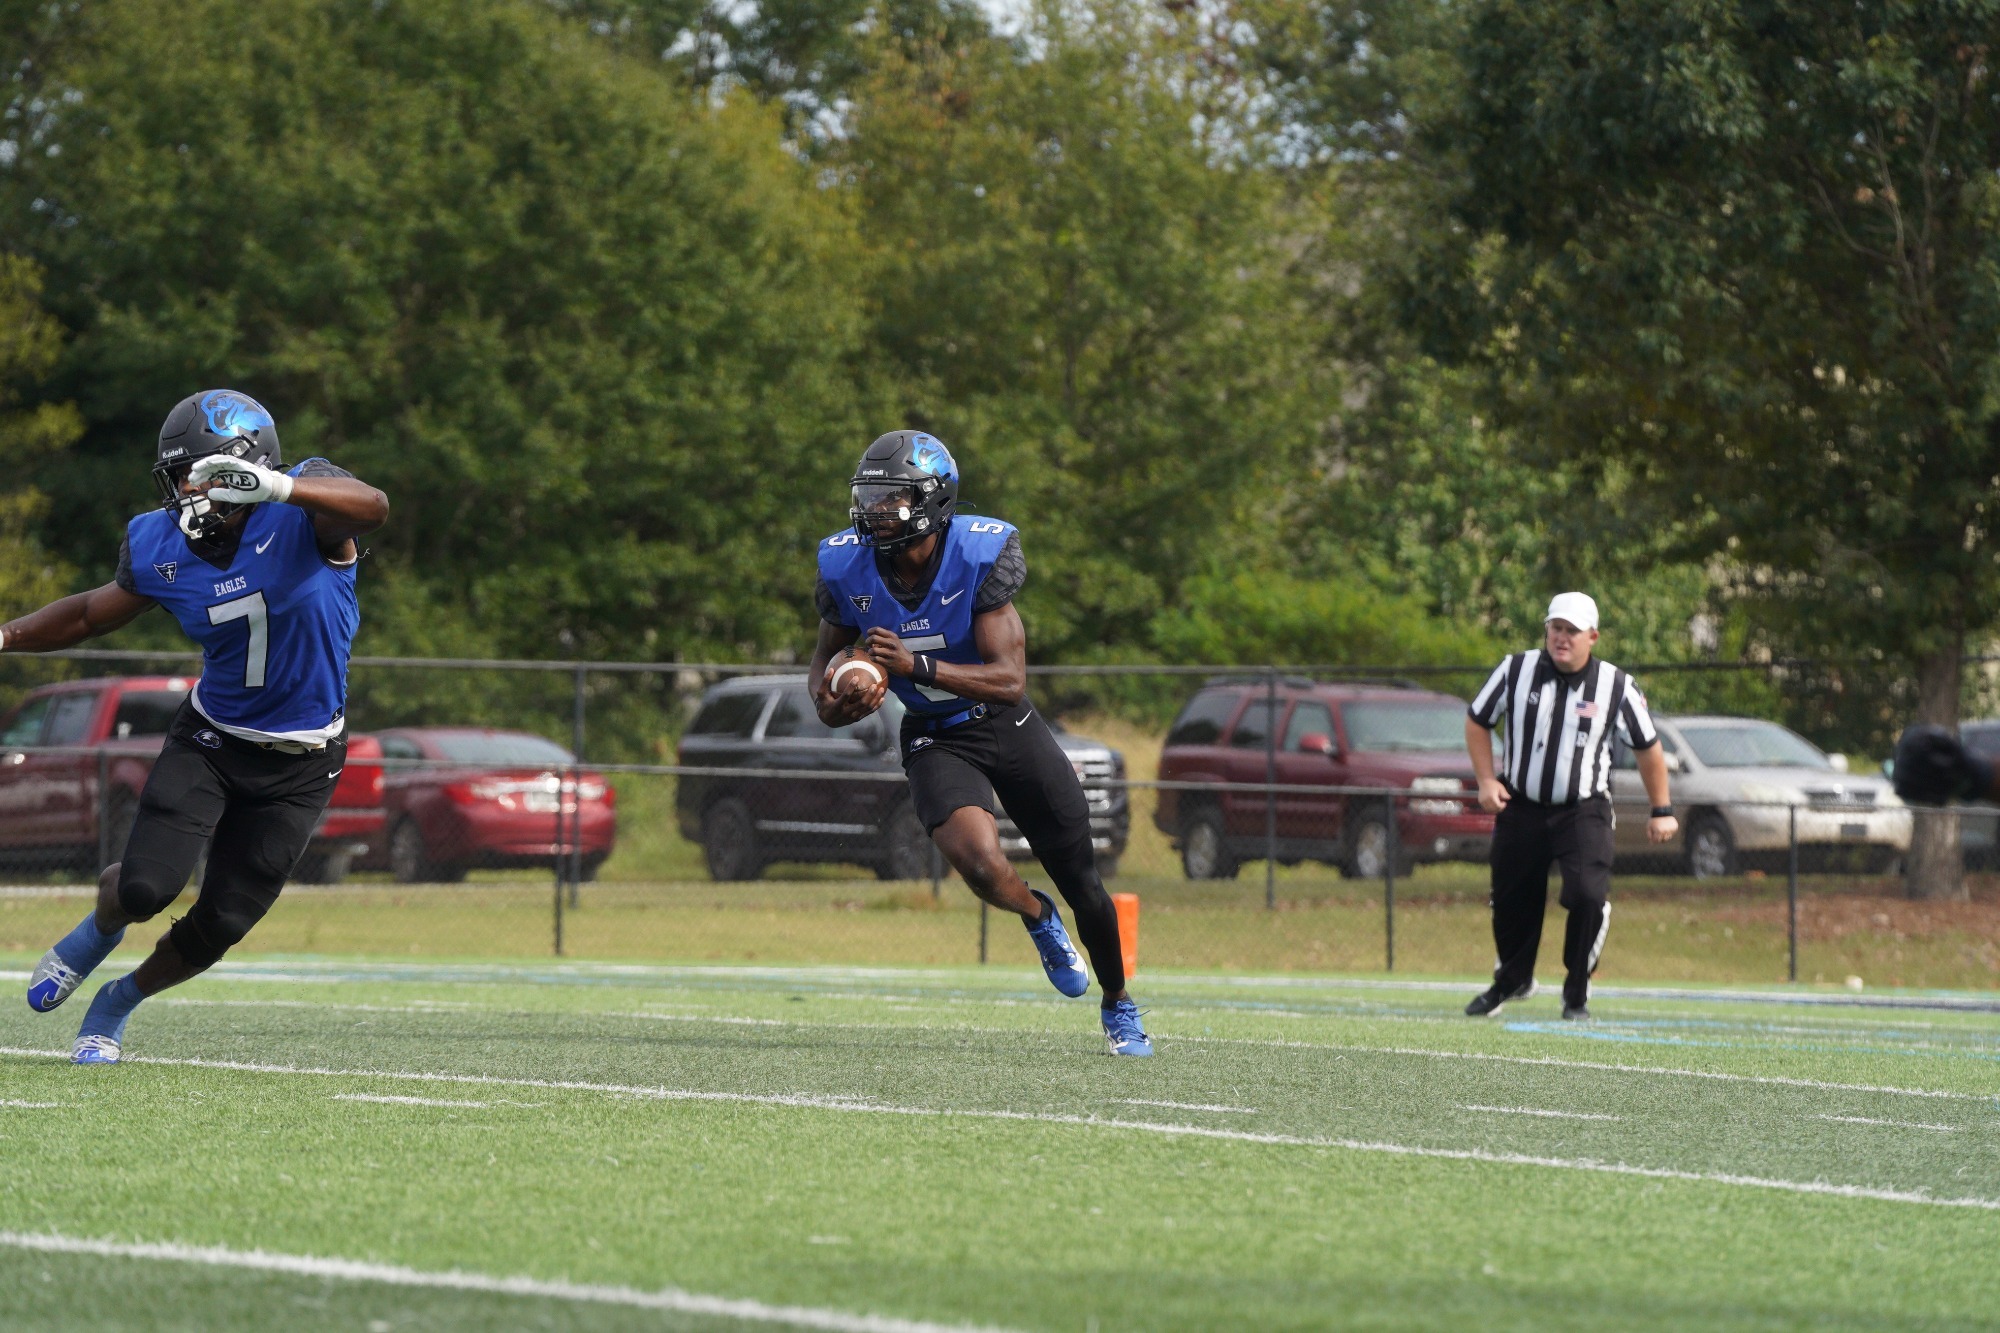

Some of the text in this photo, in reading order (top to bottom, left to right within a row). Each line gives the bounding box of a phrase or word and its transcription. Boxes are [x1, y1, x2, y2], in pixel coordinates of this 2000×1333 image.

[969, 521, 1005, 535] 5
[828, 534, 860, 547] 5
[213, 575, 247, 597] EAGLES
[900, 618, 931, 633] EAGLES
[206, 590, 268, 688] 7
